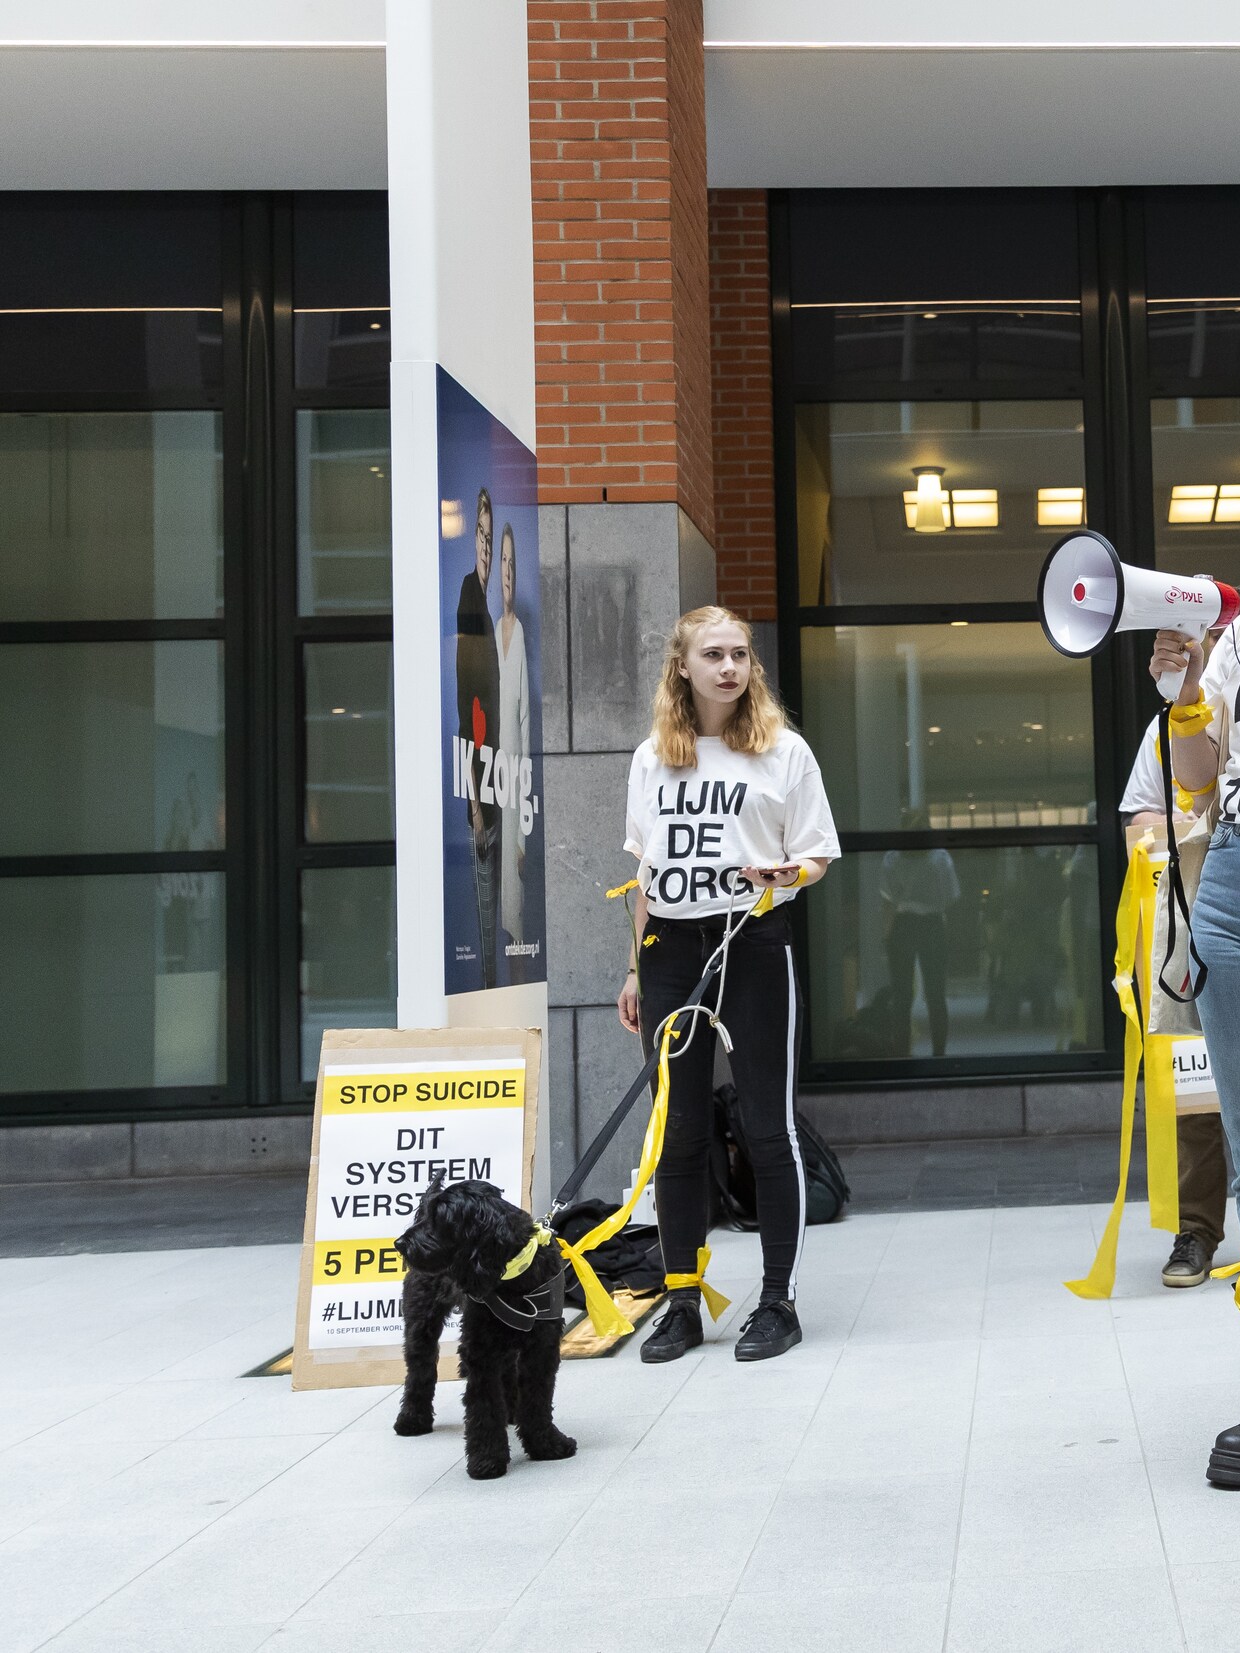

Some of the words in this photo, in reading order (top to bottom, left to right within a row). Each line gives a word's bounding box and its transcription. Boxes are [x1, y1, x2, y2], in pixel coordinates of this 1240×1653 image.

[1182, 591, 1203, 604] PYLE
[658, 781, 748, 816] LIJM
[668, 823, 724, 859] DE
[340, 1084, 408, 1105] STOP
[415, 1079, 517, 1102] SUICIDE
[396, 1127, 444, 1151] DIT
[345, 1157, 492, 1186] SYSTEEM
[331, 1192, 422, 1219] VERS
[324, 1252, 342, 1277] 5
[337, 1326, 381, 1335] SEPTEMBER
[383, 1324, 403, 1332] WORL
